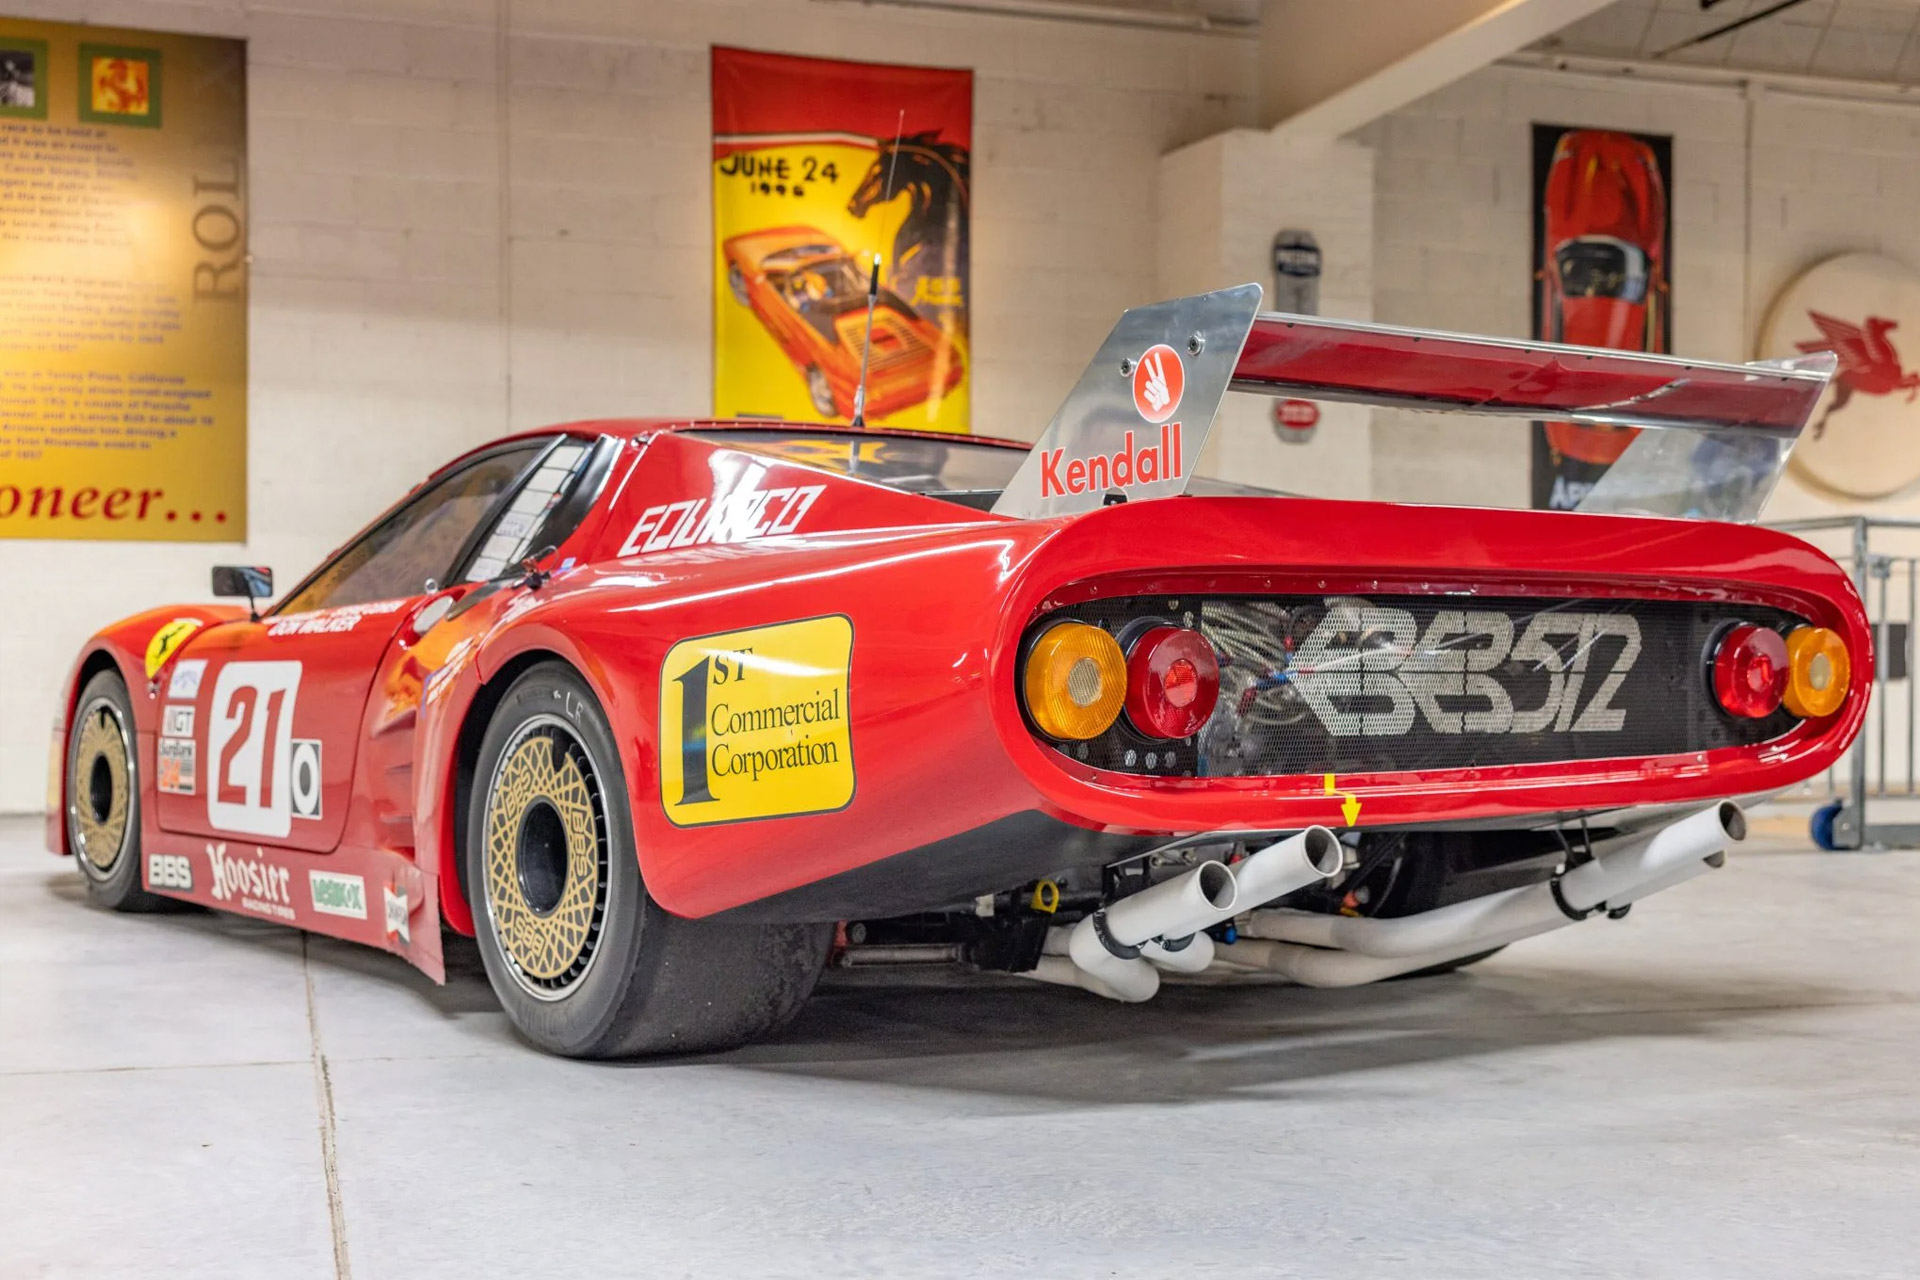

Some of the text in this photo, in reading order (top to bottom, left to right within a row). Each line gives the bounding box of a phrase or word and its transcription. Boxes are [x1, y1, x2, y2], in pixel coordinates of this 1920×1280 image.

[720, 154, 839, 183] JUNE 24
[1040, 421, 1182, 498] Kendall
[711, 688, 840, 736] Commercial
[217, 685, 287, 809] 21
[711, 734, 838, 782] Corporation
[571, 809, 589, 878] BBS
[148, 854, 193, 889] BBS
